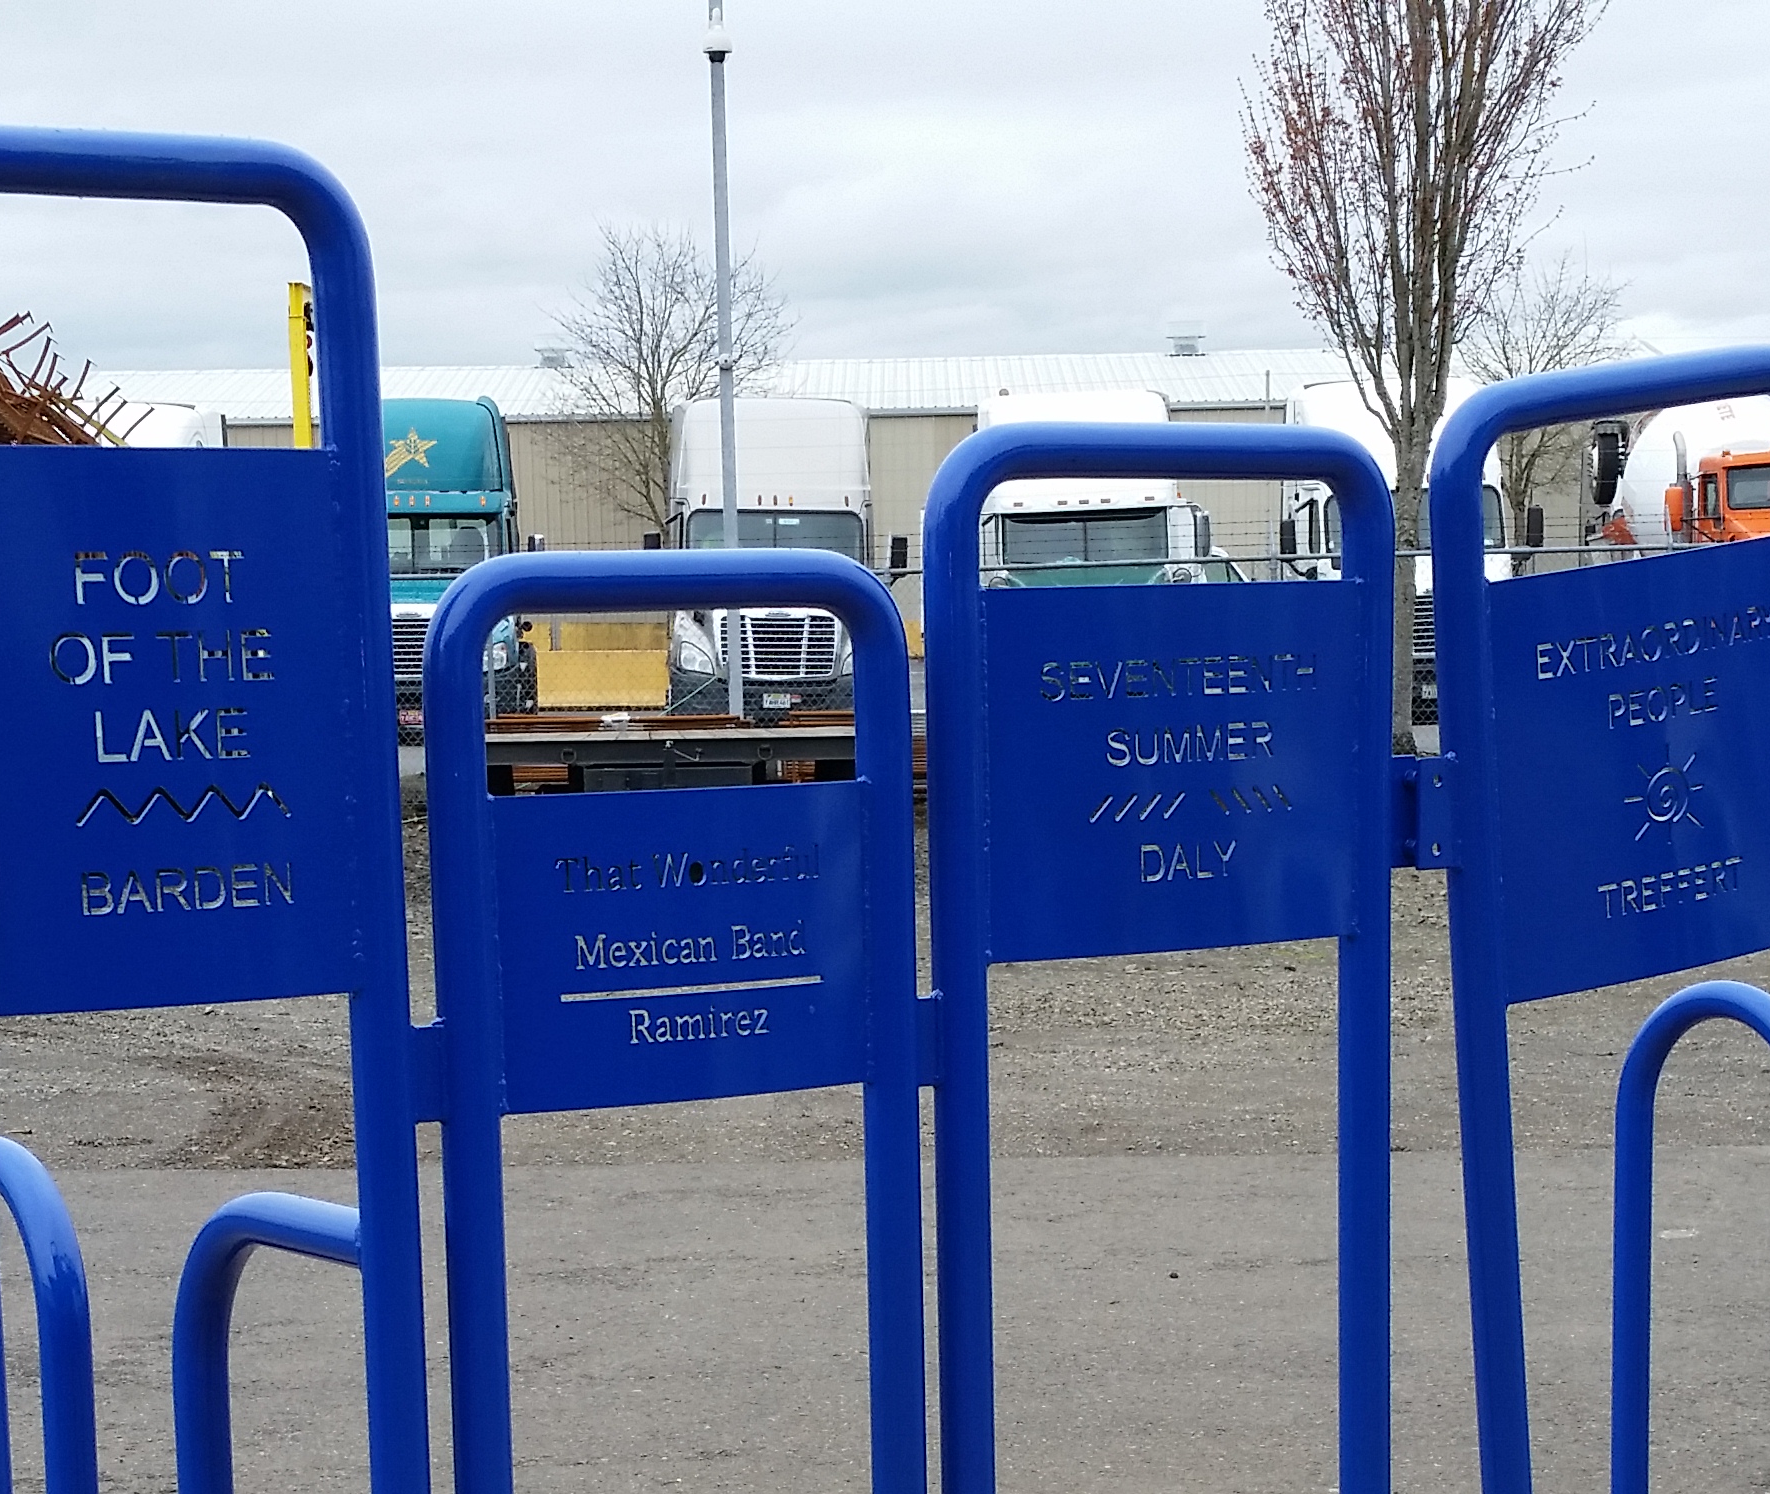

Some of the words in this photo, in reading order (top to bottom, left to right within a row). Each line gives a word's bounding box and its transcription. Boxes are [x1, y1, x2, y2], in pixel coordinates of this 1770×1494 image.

[73, 550, 245, 605] FOOT
[49, 631, 134, 685] OF
[156, 628, 275, 683] THE
[1040, 653, 1317, 702] SEVENTEENTH
[1607, 676, 1719, 730] PEOPLE
[94, 707, 251, 764] LAKE
[1106, 721, 1275, 767] SUMMER
[555, 855, 643, 894] That
[653, 842, 822, 889] Wonderful
[1139, 839, 1237, 883] DALY
[1597, 856, 1743, 919] TREFFERT
[80, 862, 295, 917] BARDEN
[574, 930, 718, 971] Mexican
[731, 919, 807, 961] Band
[629, 1004, 771, 1045] Ramirez
